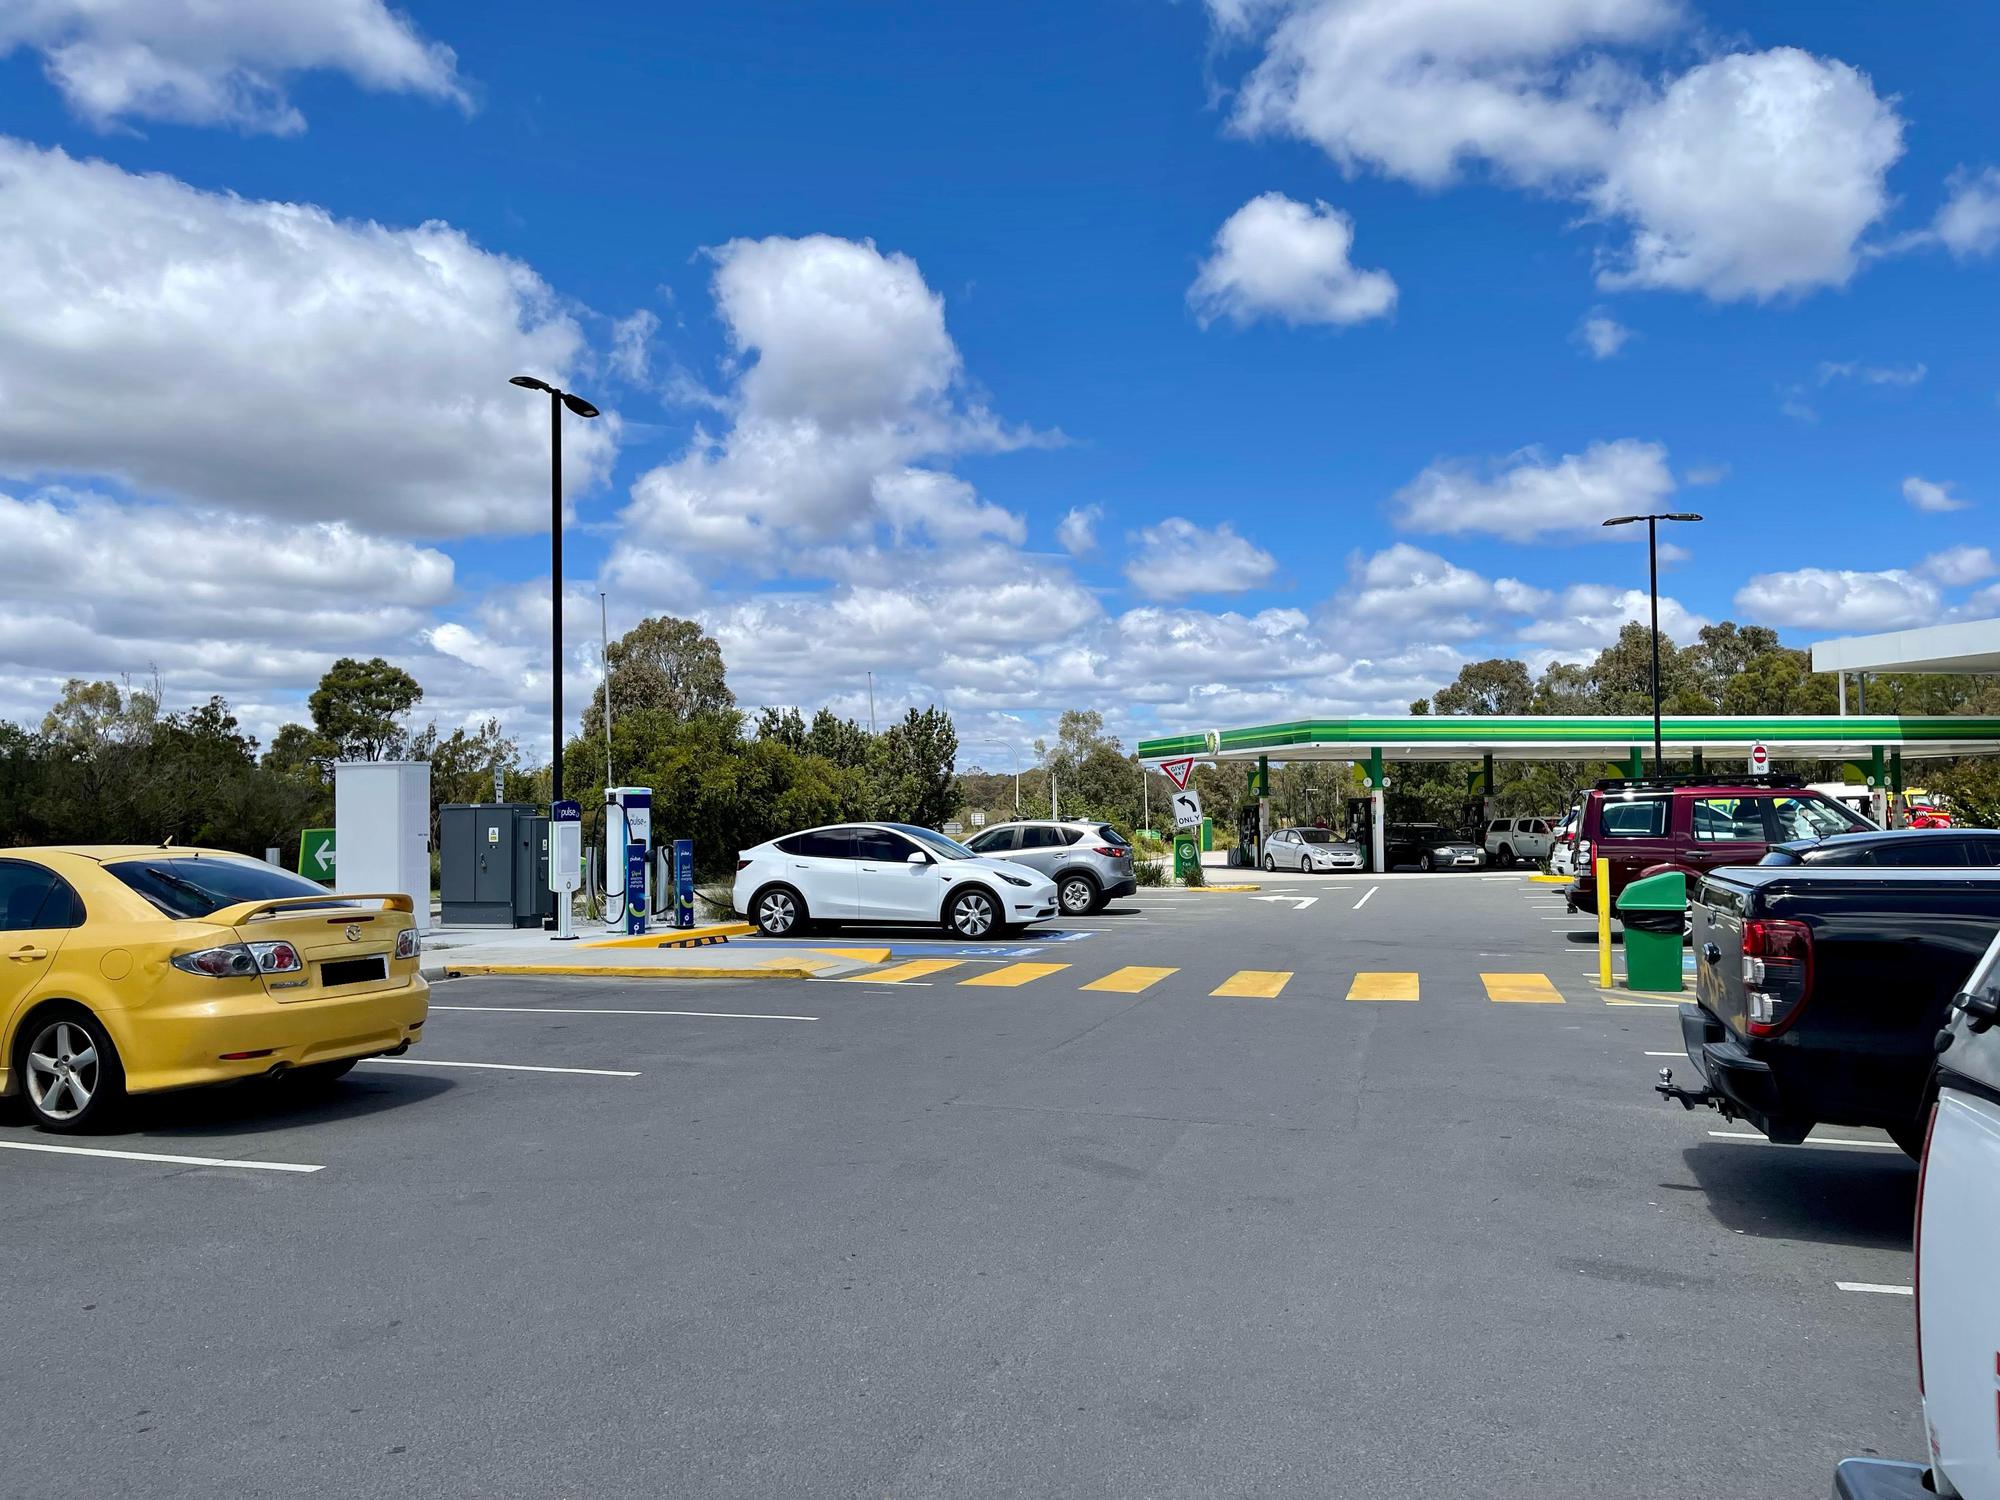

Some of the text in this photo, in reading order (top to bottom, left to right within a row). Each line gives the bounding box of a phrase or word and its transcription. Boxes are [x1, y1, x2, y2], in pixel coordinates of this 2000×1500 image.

[560, 806, 576, 819] pulse
[630, 816, 645, 826] pulse
[1179, 815, 1200, 824] ONLY
